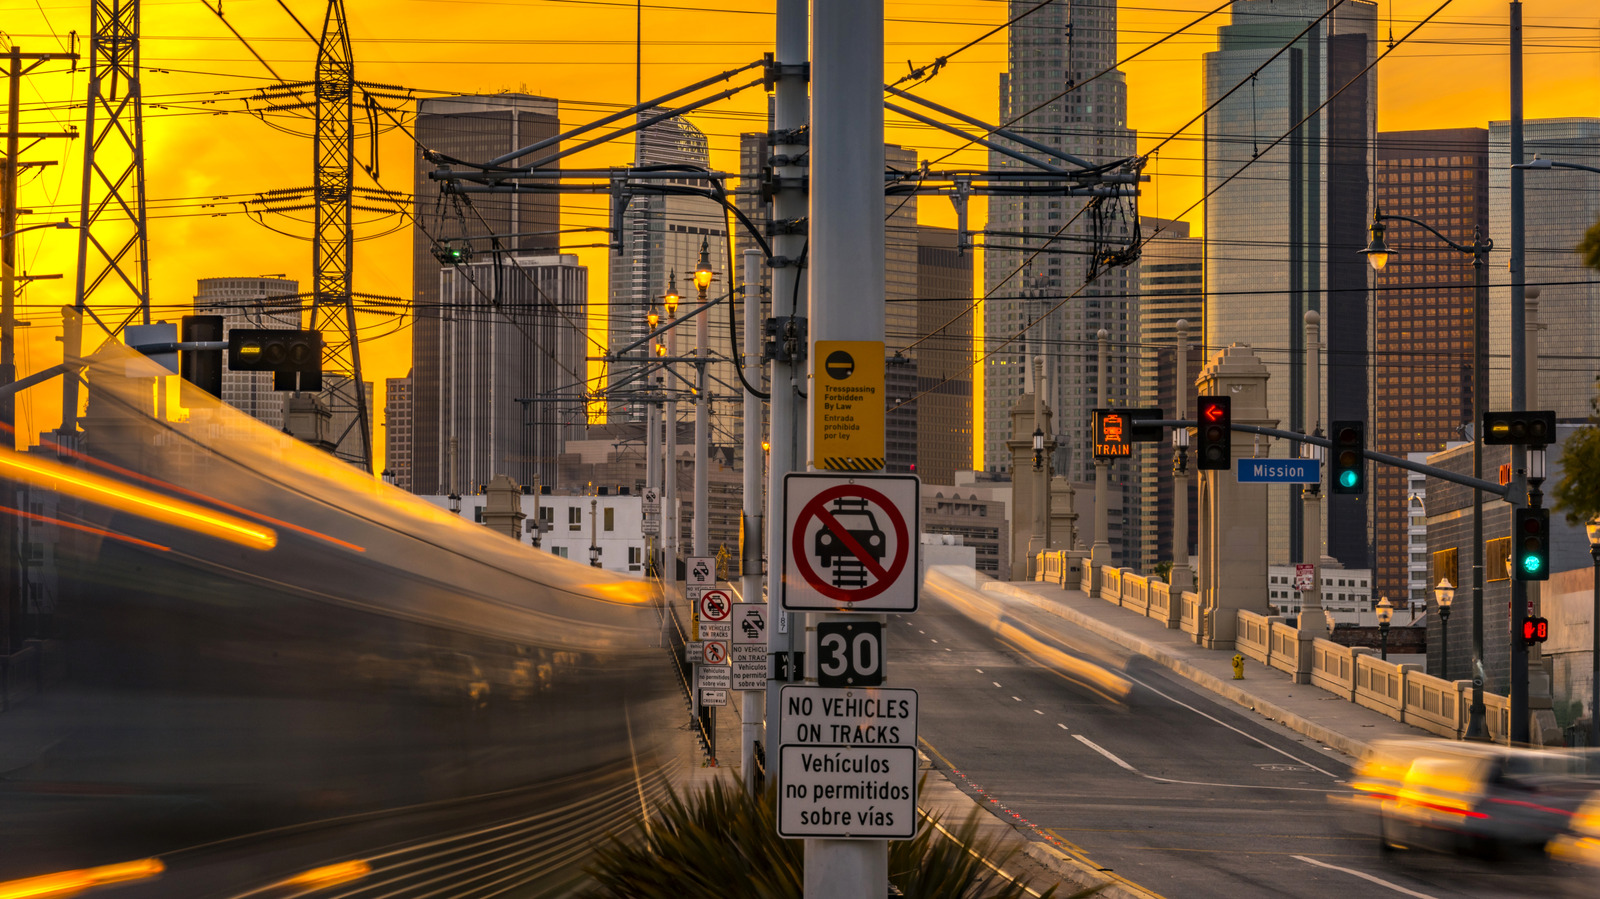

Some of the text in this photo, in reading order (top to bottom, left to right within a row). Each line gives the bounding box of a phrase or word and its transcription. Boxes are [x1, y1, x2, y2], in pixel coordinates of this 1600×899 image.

[825, 385, 876, 394] Tresspassing
[824, 402, 835, 411] By
[824, 414, 854, 422] Entrada
[824, 423, 860, 431] prohibida
[839, 432, 851, 440] ley
[1096, 444, 1130, 455] TRAIN
[1253, 464, 1304, 477] Mission
[820, 632, 879, 677] 30
[788, 697, 909, 719] NO VEHICLES
[797, 723, 900, 743] ON TRACKS
[801, 752, 890, 773] Vehículos
[786, 781, 910, 804] no permitidos
[800, 806, 894, 826] sobre vías
